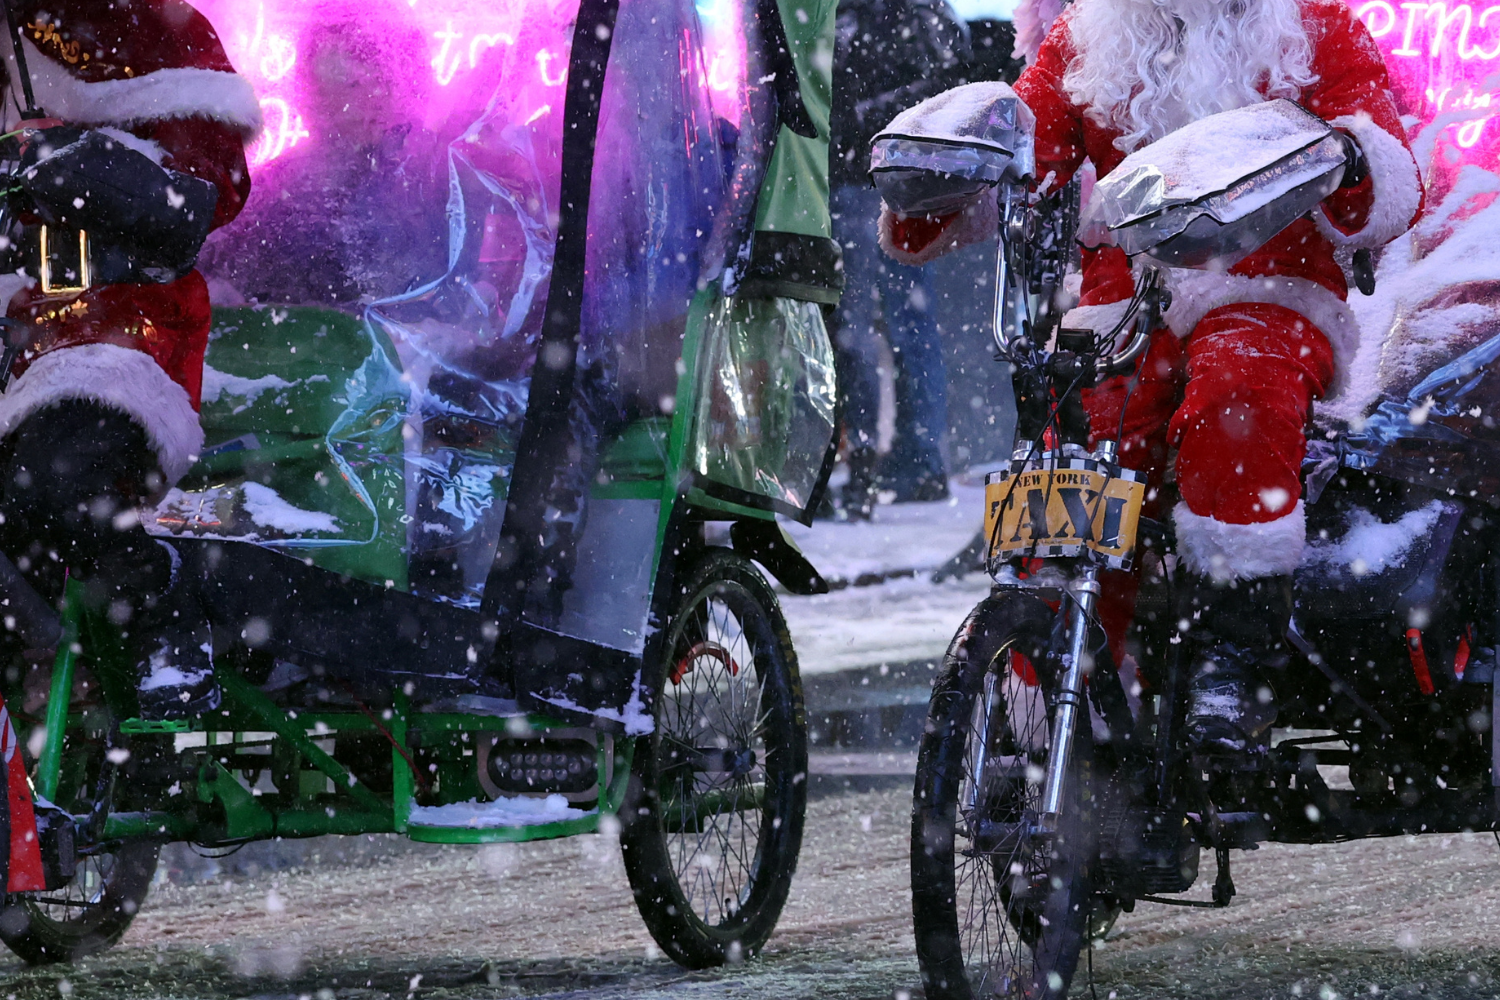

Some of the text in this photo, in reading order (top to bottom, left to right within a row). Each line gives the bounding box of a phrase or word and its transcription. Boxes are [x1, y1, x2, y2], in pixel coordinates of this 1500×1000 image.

[1013, 472, 1092, 488] NEW YORK
[991, 487, 1128, 550] TAXI
